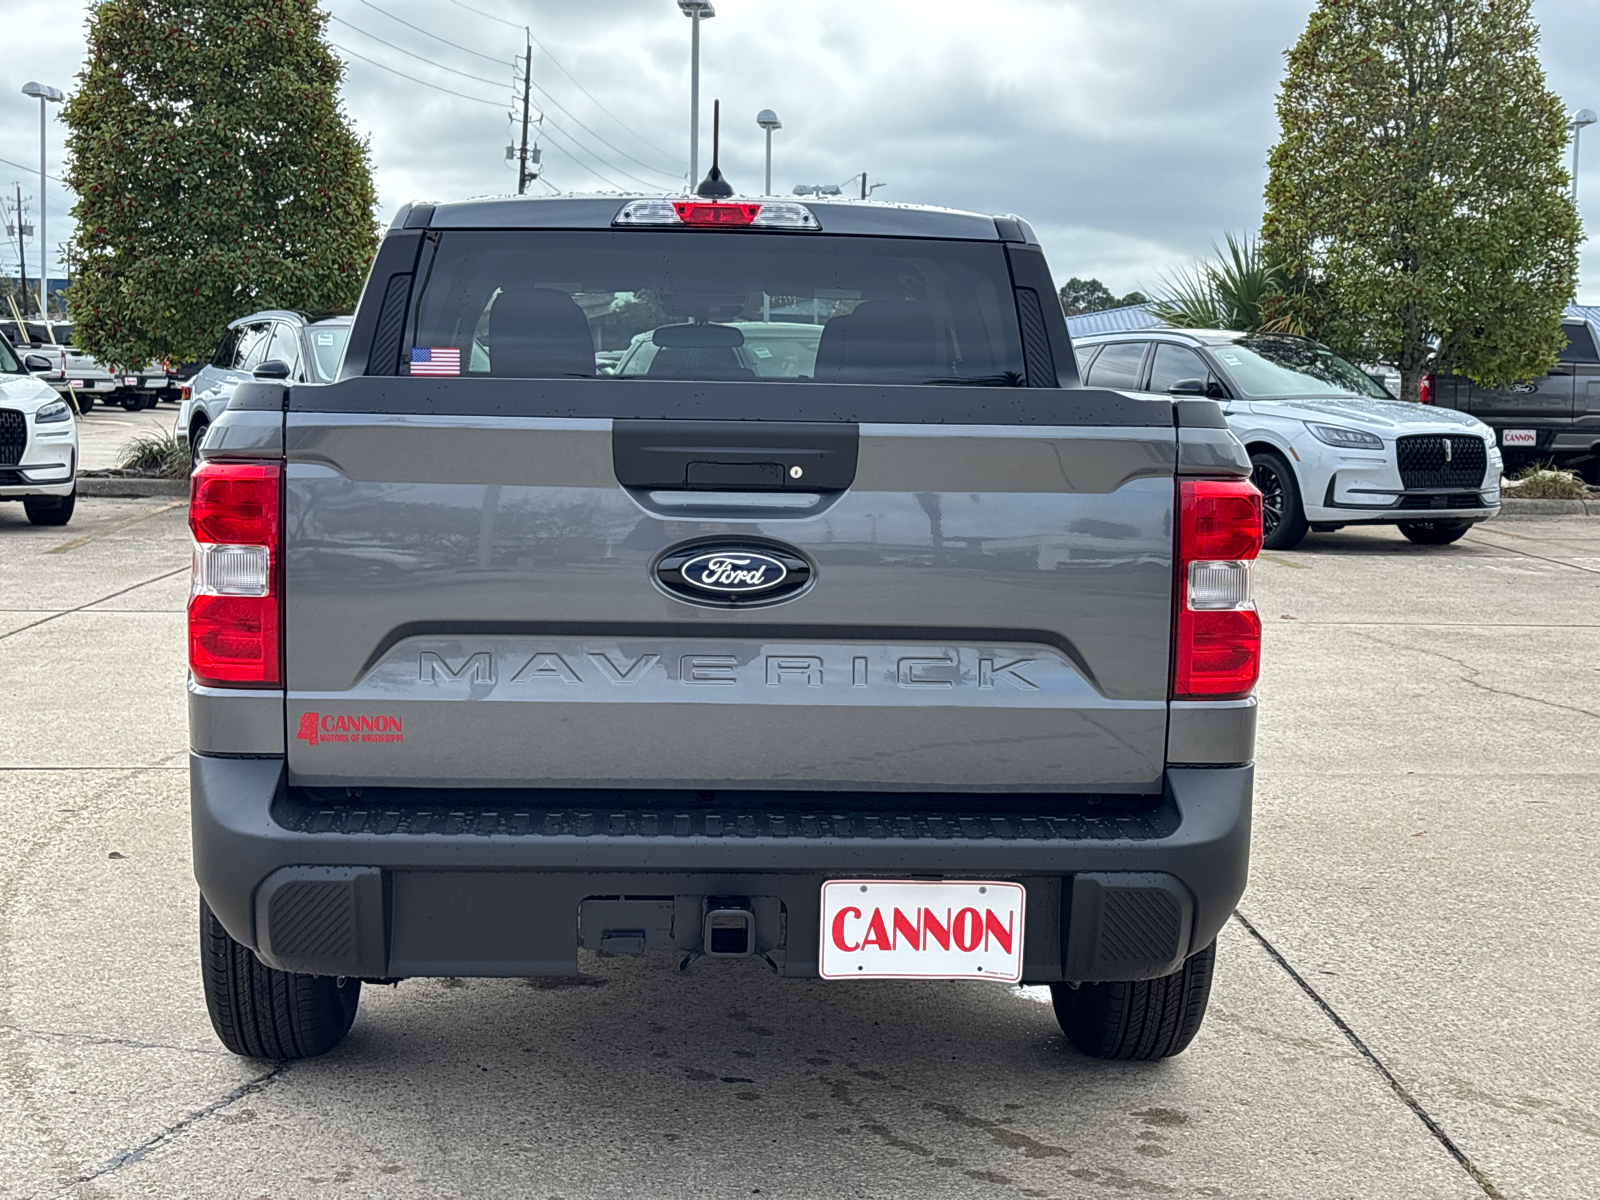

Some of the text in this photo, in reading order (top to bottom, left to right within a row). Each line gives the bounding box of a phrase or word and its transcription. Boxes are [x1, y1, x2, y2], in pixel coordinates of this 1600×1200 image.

[1504, 433, 1535, 442] CANNON
[702, 557, 767, 585] Ford
[418, 650, 1040, 691] MAVERICK
[320, 714, 403, 732] CANNON
[320, 733, 404, 743] MOTORS OF MISSISSIPPI
[831, 906, 1014, 955] CANNON
